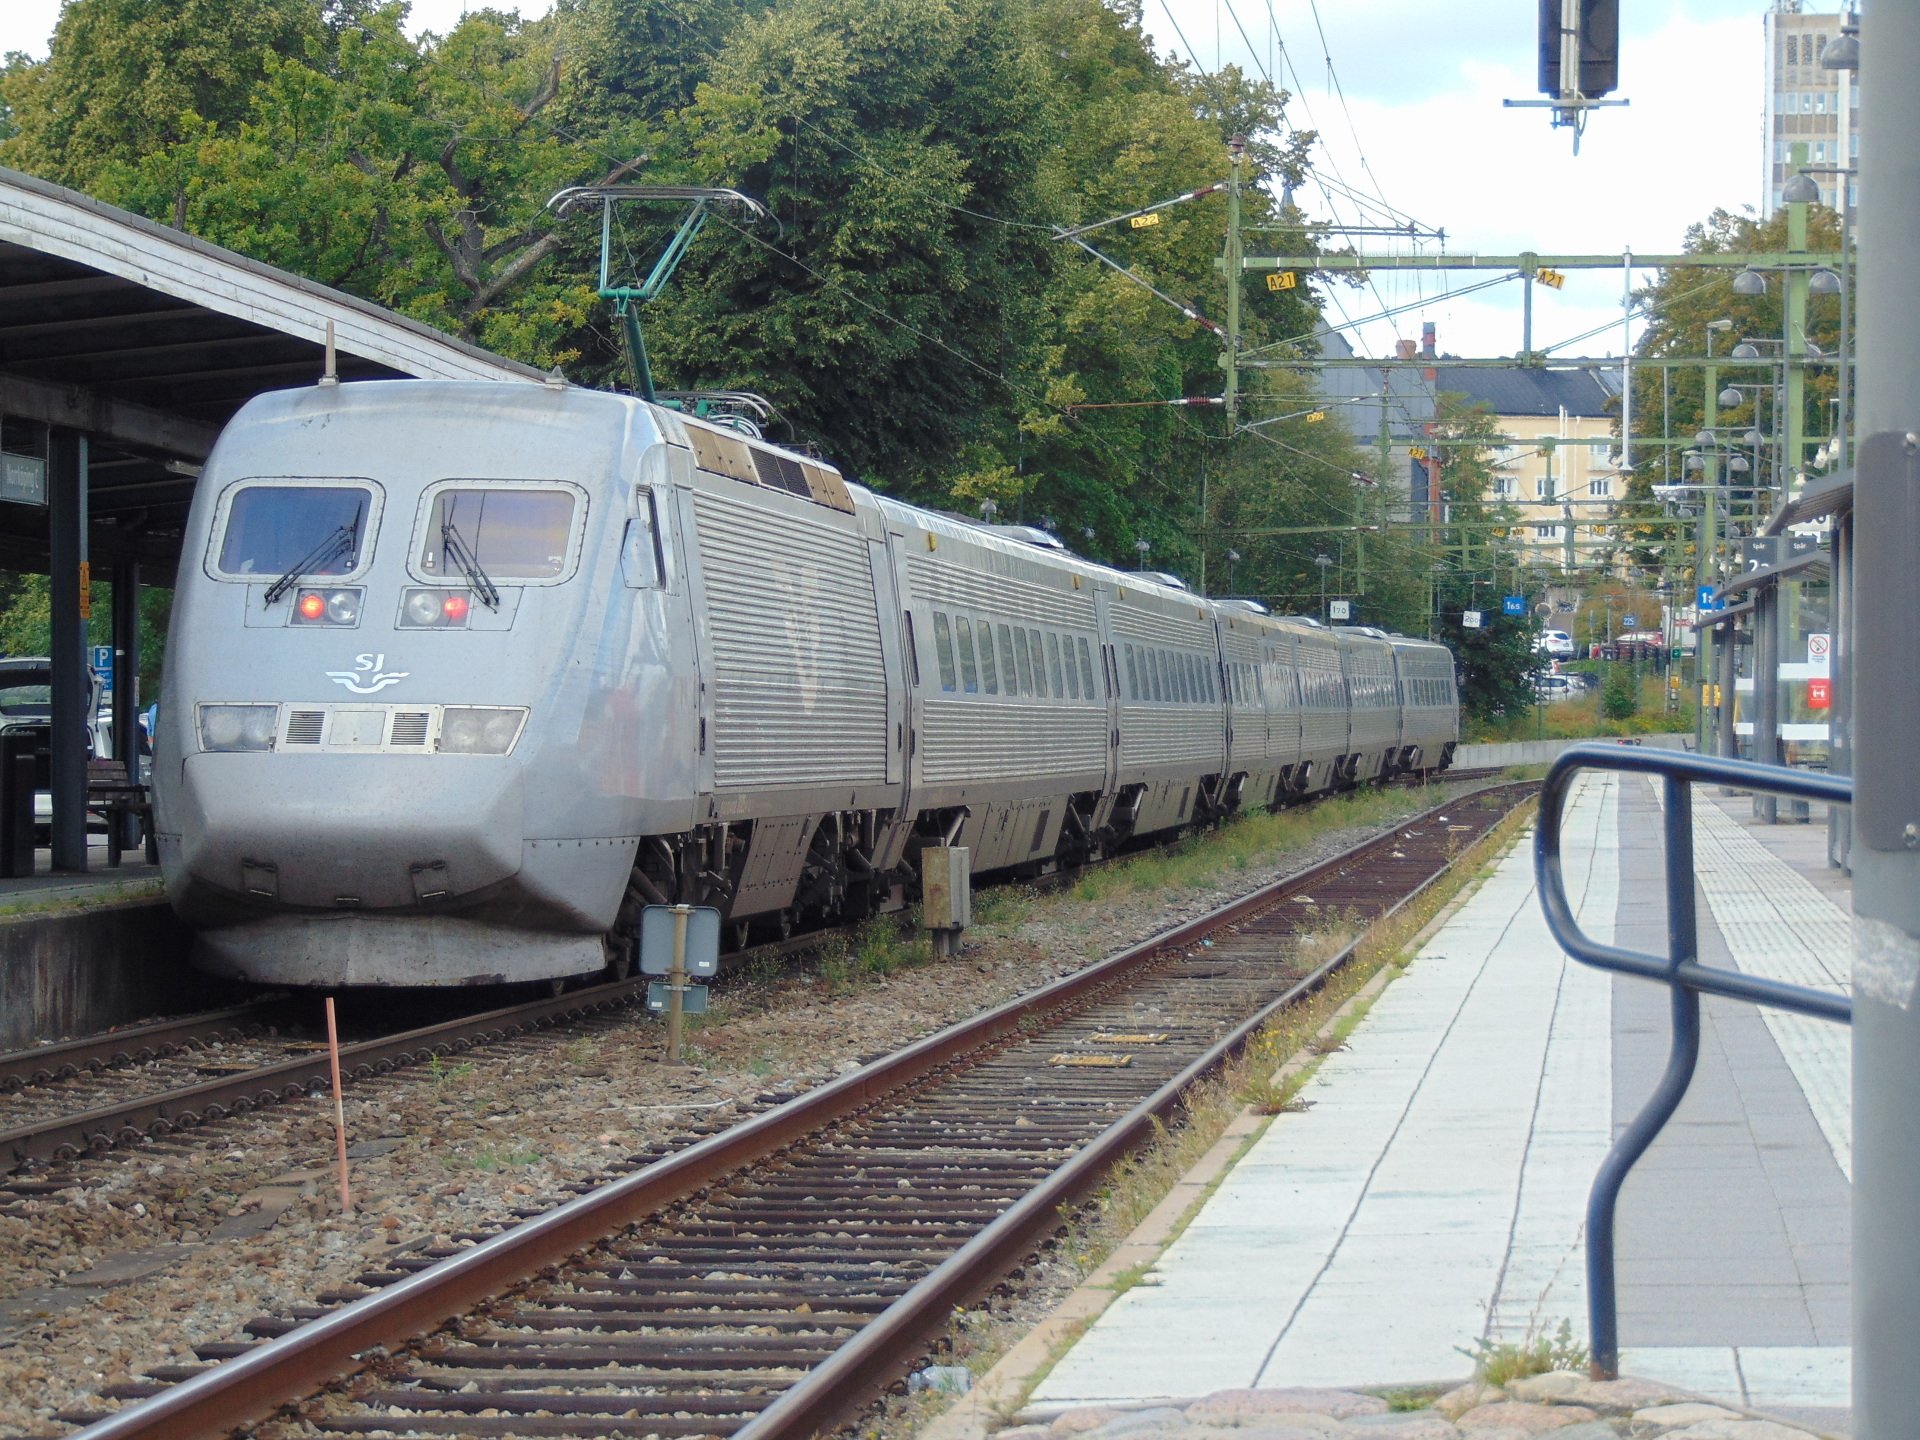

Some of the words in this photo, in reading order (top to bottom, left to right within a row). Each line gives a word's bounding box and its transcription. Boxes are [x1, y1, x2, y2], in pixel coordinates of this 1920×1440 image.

[1133, 215, 1157, 227] A22
[1270, 274, 1292, 289] A21
[1537, 270, 1562, 288] A21
[1793, 542, 1808, 550] Spår
[1333, 605, 1346, 614] 170
[1507, 601, 1521, 610] 165
[1464, 615, 1479, 624] 200
[99, 648, 109, 666] P
[355, 653, 385, 672] SJ
